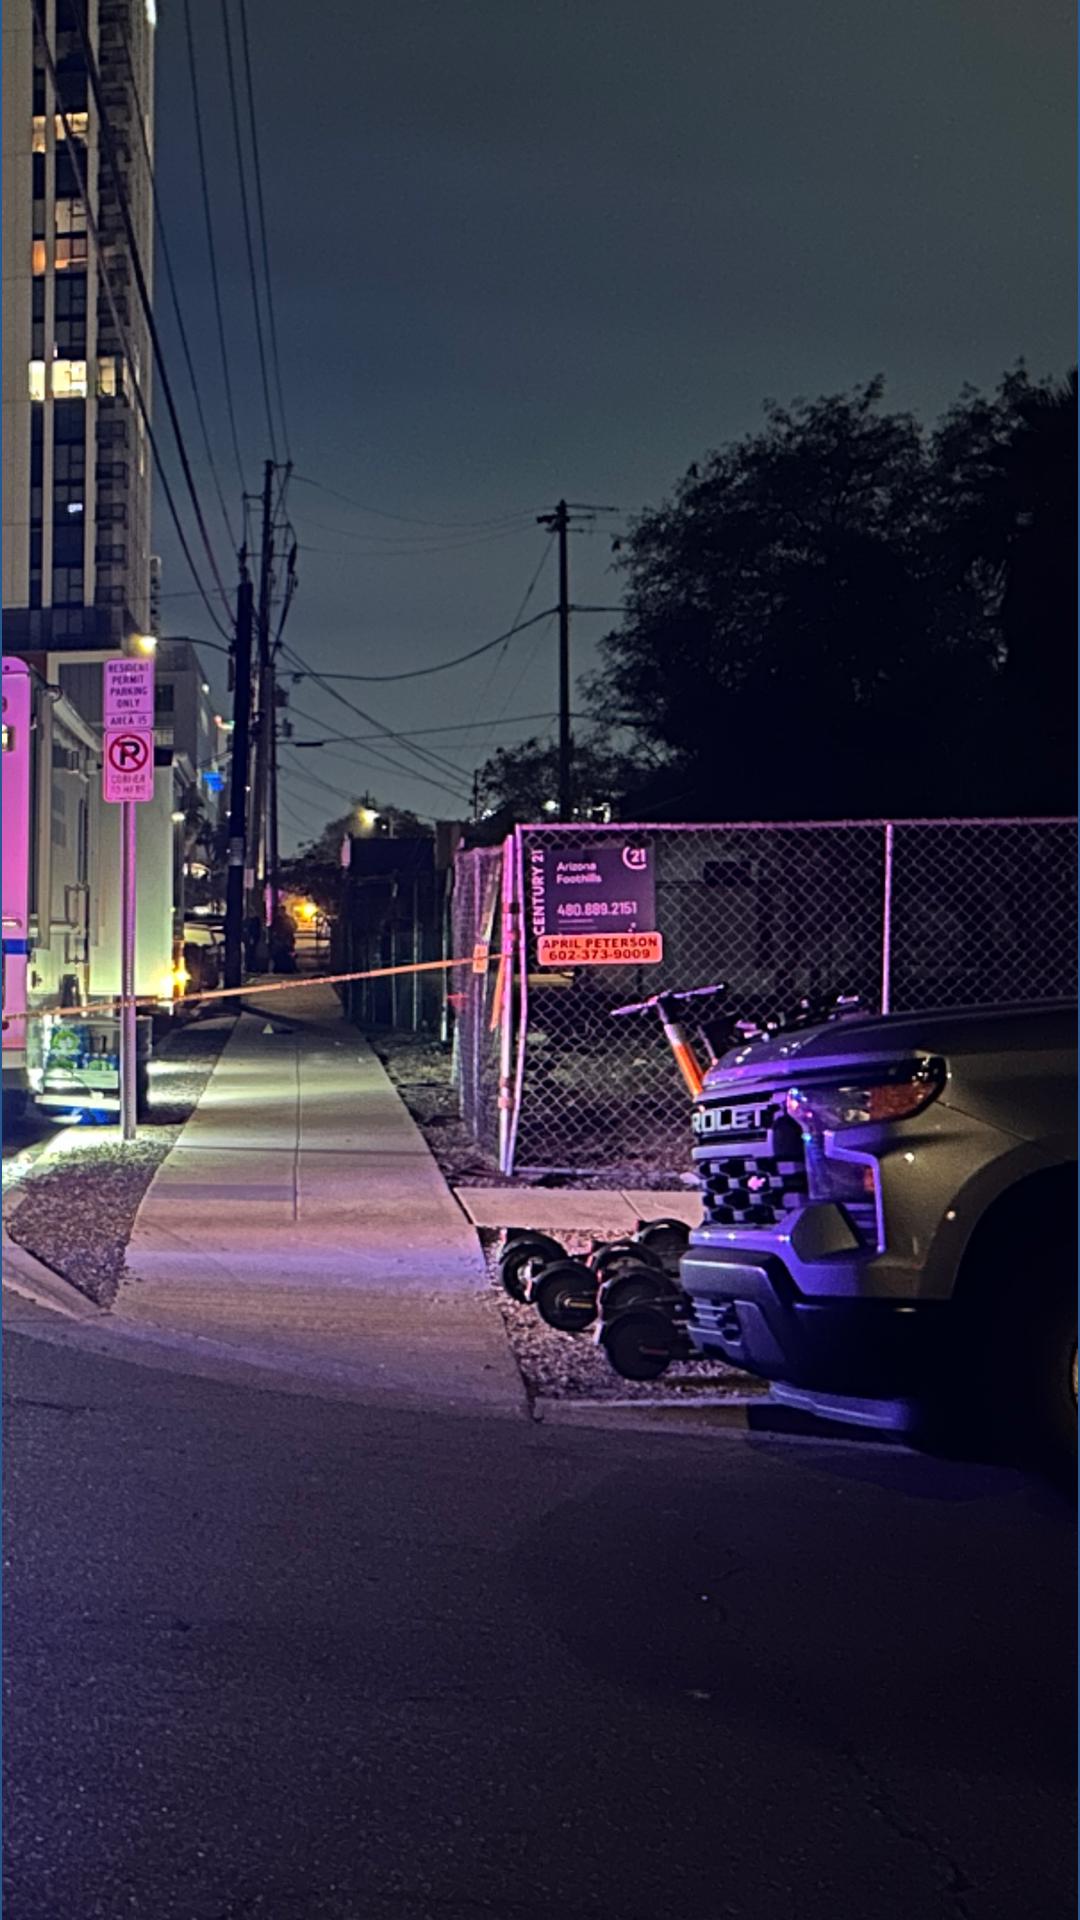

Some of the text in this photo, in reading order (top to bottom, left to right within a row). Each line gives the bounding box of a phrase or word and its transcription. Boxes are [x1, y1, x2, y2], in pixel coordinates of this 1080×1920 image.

[112, 674, 144, 685] PERMIT
[110, 686, 148, 696] PARKING
[116, 698, 140, 708] ONLY
[110, 716, 134, 725] AREA
[556, 861, 597, 872] Arizona
[556, 874, 602, 884] Foothills
[531, 849, 546, 936] CENTURY 21
[542, 937, 658, 949] APRIL PETERSON
[549, 949, 651, 961] 602-373-9009
